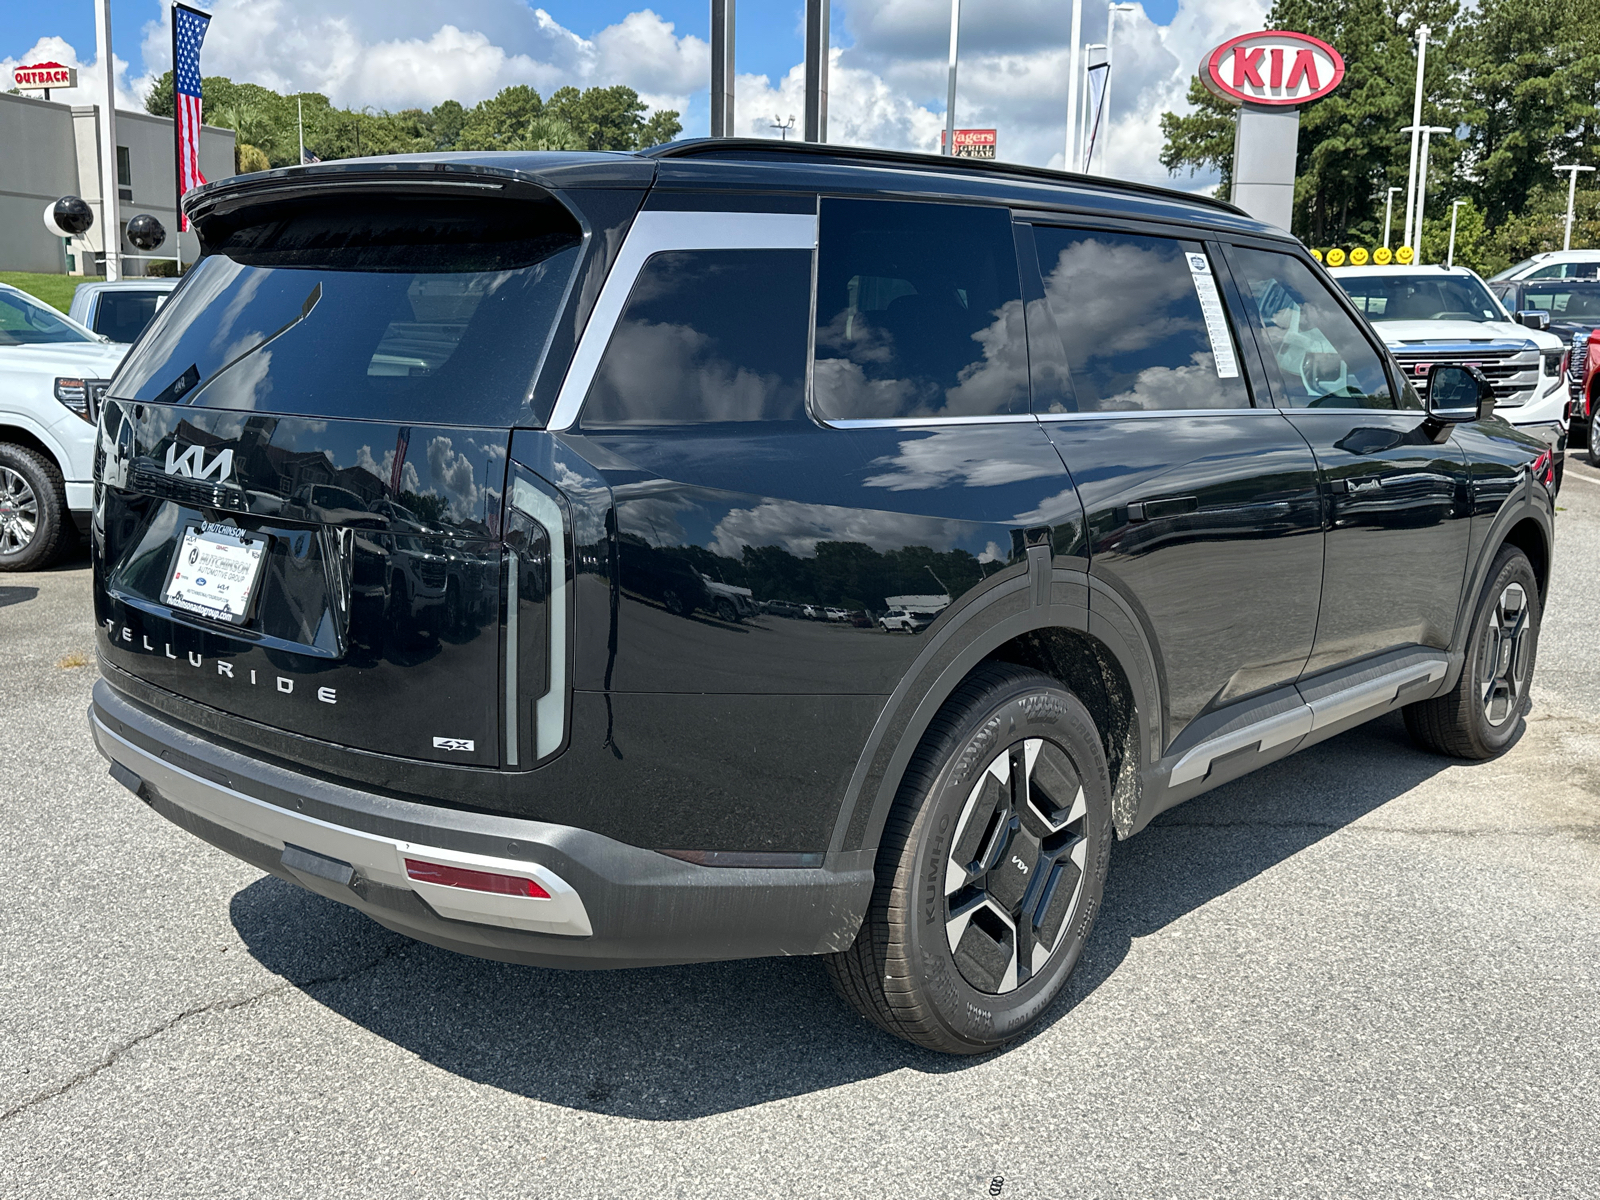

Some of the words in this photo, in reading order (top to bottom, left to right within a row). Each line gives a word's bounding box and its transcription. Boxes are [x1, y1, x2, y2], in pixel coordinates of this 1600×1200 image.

[15, 71, 68, 84] OUTBACK
[1233, 47, 1320, 89] KIA
[971, 150, 994, 158] BAR
[208, 523, 246, 538] HUTCHINSON
[197, 566, 228, 580] AUTOMOTIVE
[227, 573, 246, 583] GROUP
[199, 552, 251, 575] HUTCHINSON
[105, 618, 337, 704] TELLURIDE
[1070, 715, 1107, 781] CRUGEN
[925, 813, 950, 925] KUMHO
